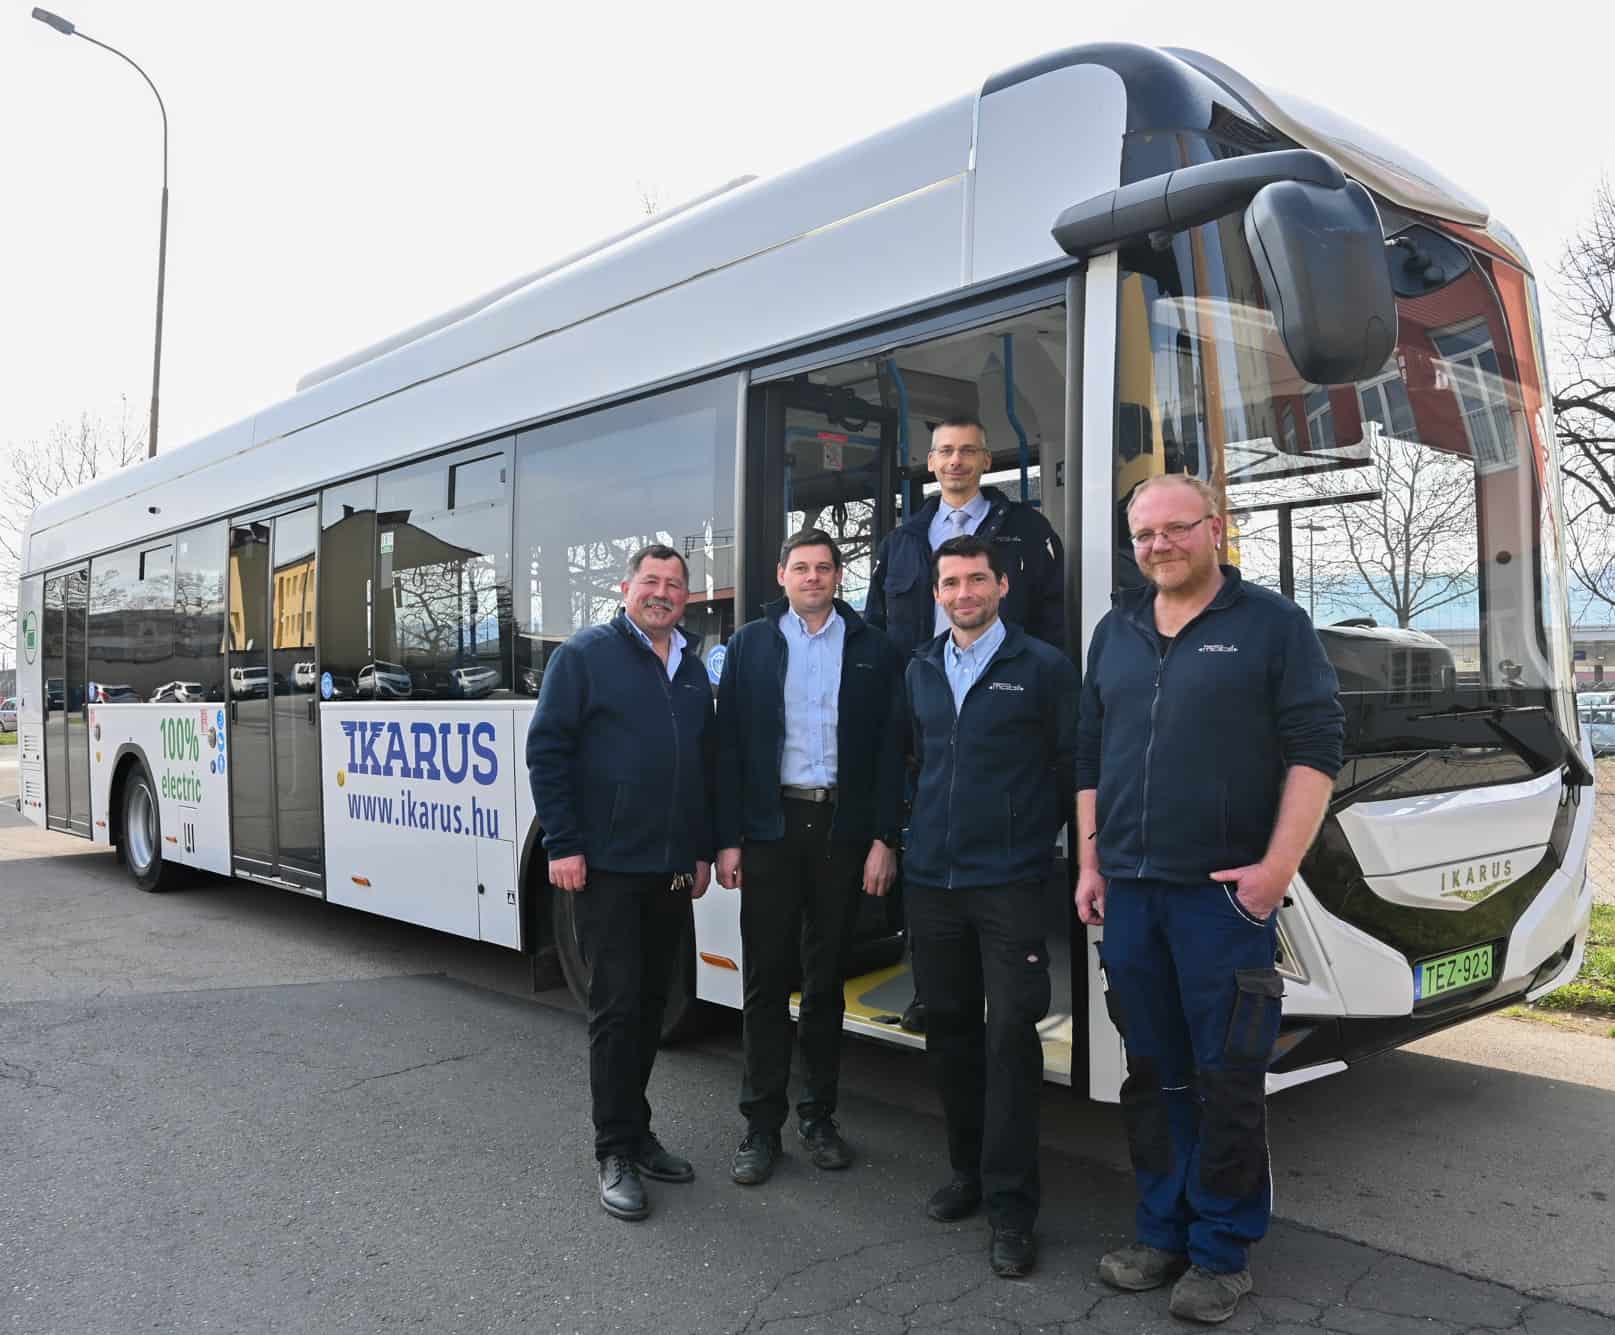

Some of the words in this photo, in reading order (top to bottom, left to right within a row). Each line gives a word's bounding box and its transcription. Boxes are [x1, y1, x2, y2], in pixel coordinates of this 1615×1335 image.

[160, 718, 199, 762] 100%
[340, 721, 498, 785] IKARUS
[161, 768, 202, 803] electric
[347, 789, 499, 839] www.ikarus.hu
[1441, 860, 1512, 891] IKARUS
[1426, 950, 1489, 993] TEZ-923
